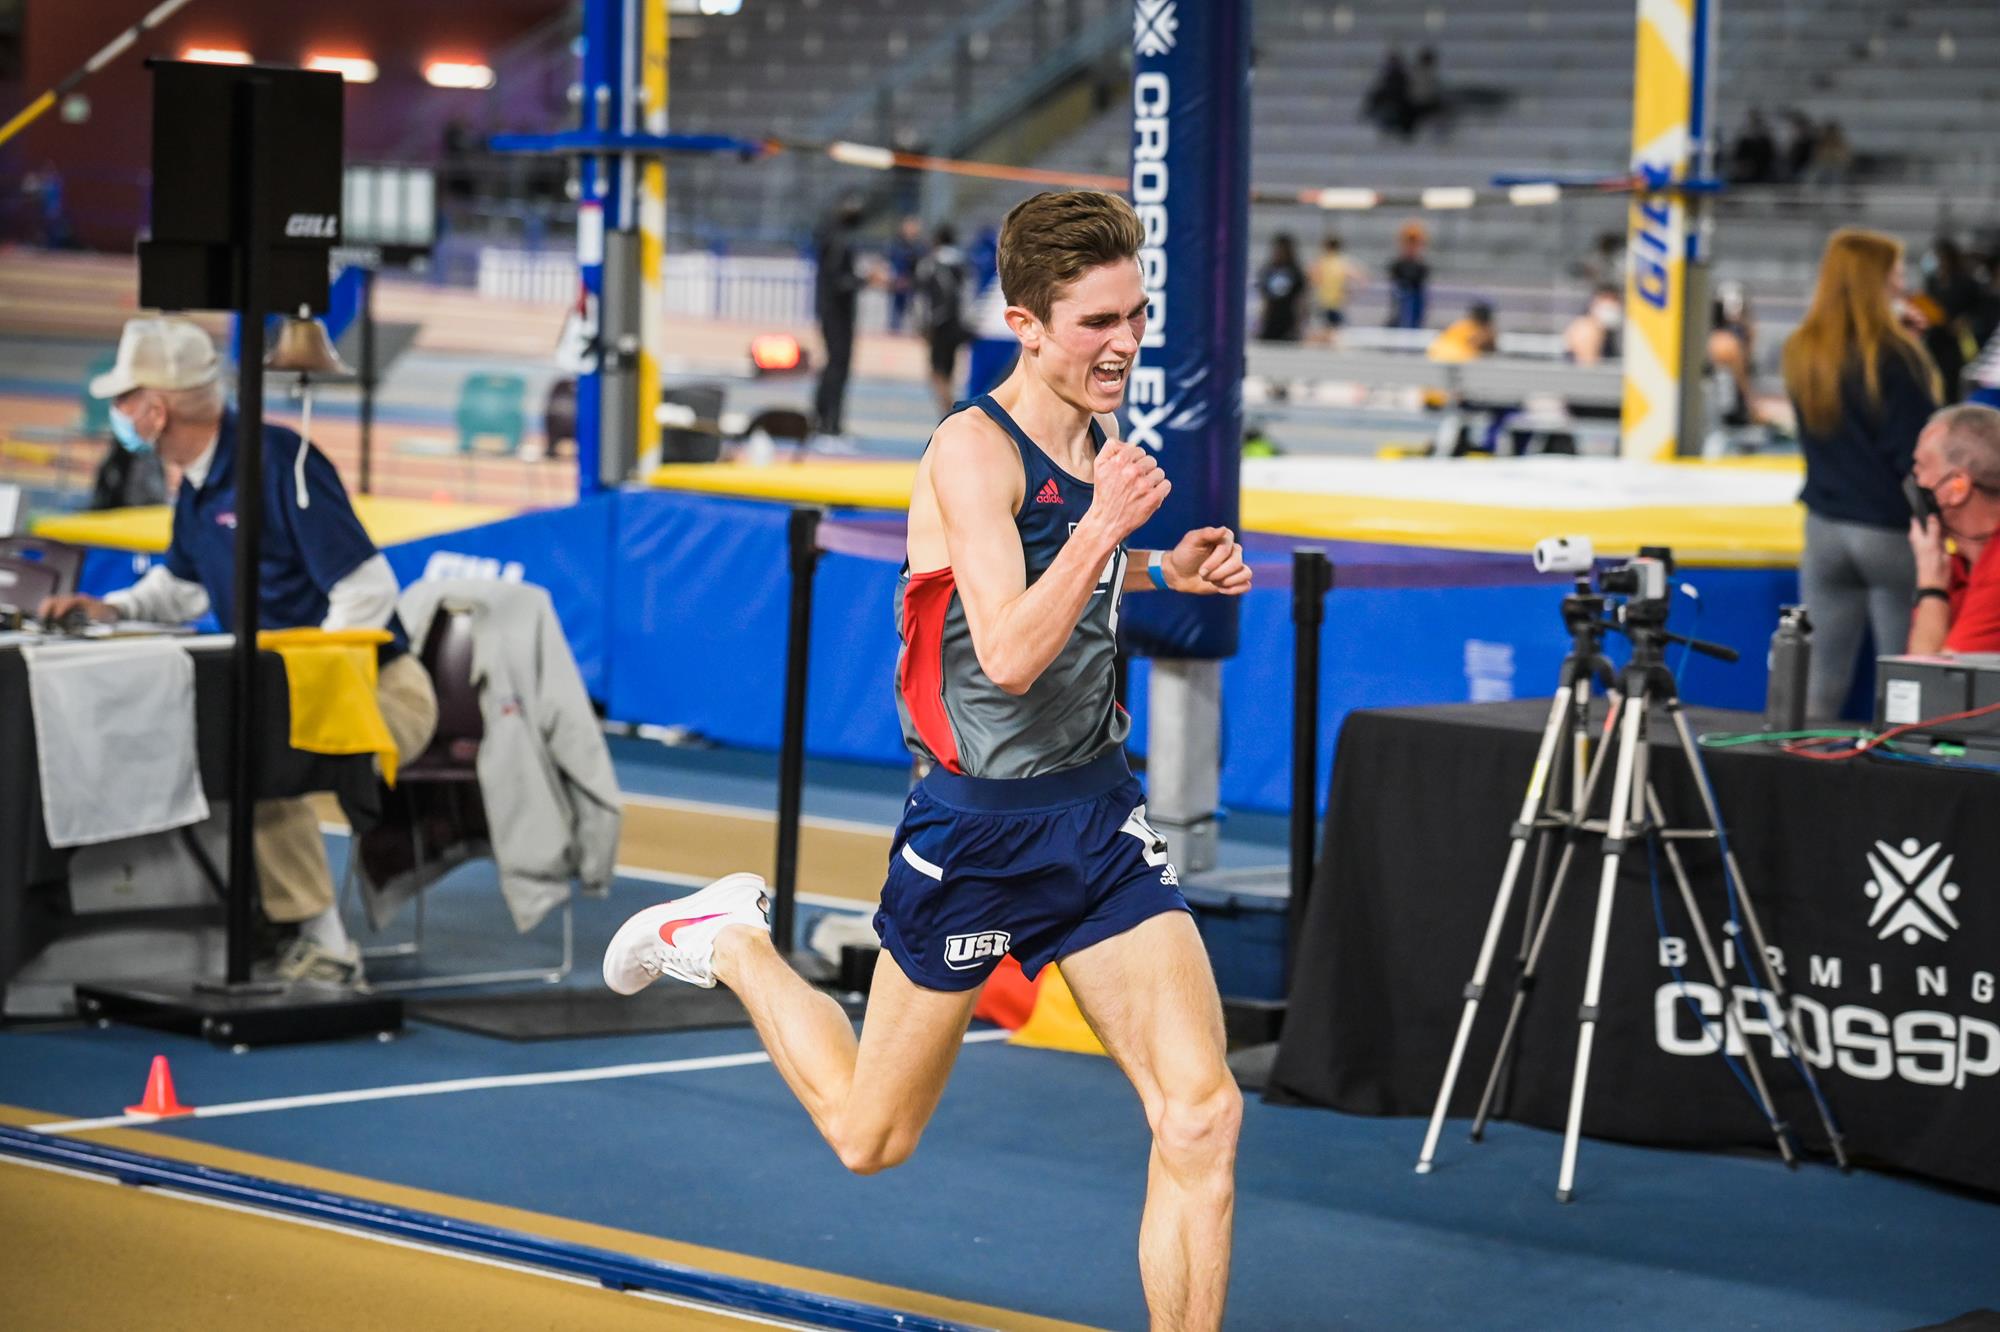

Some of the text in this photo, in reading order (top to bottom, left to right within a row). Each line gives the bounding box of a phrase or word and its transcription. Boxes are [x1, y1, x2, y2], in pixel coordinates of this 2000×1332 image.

[285, 214, 337, 238] GILL
[1127, 71, 1170, 452] CROSSPLEX
[947, 933, 1007, 962] USI
[1654, 980, 2000, 1090] CROSSP
